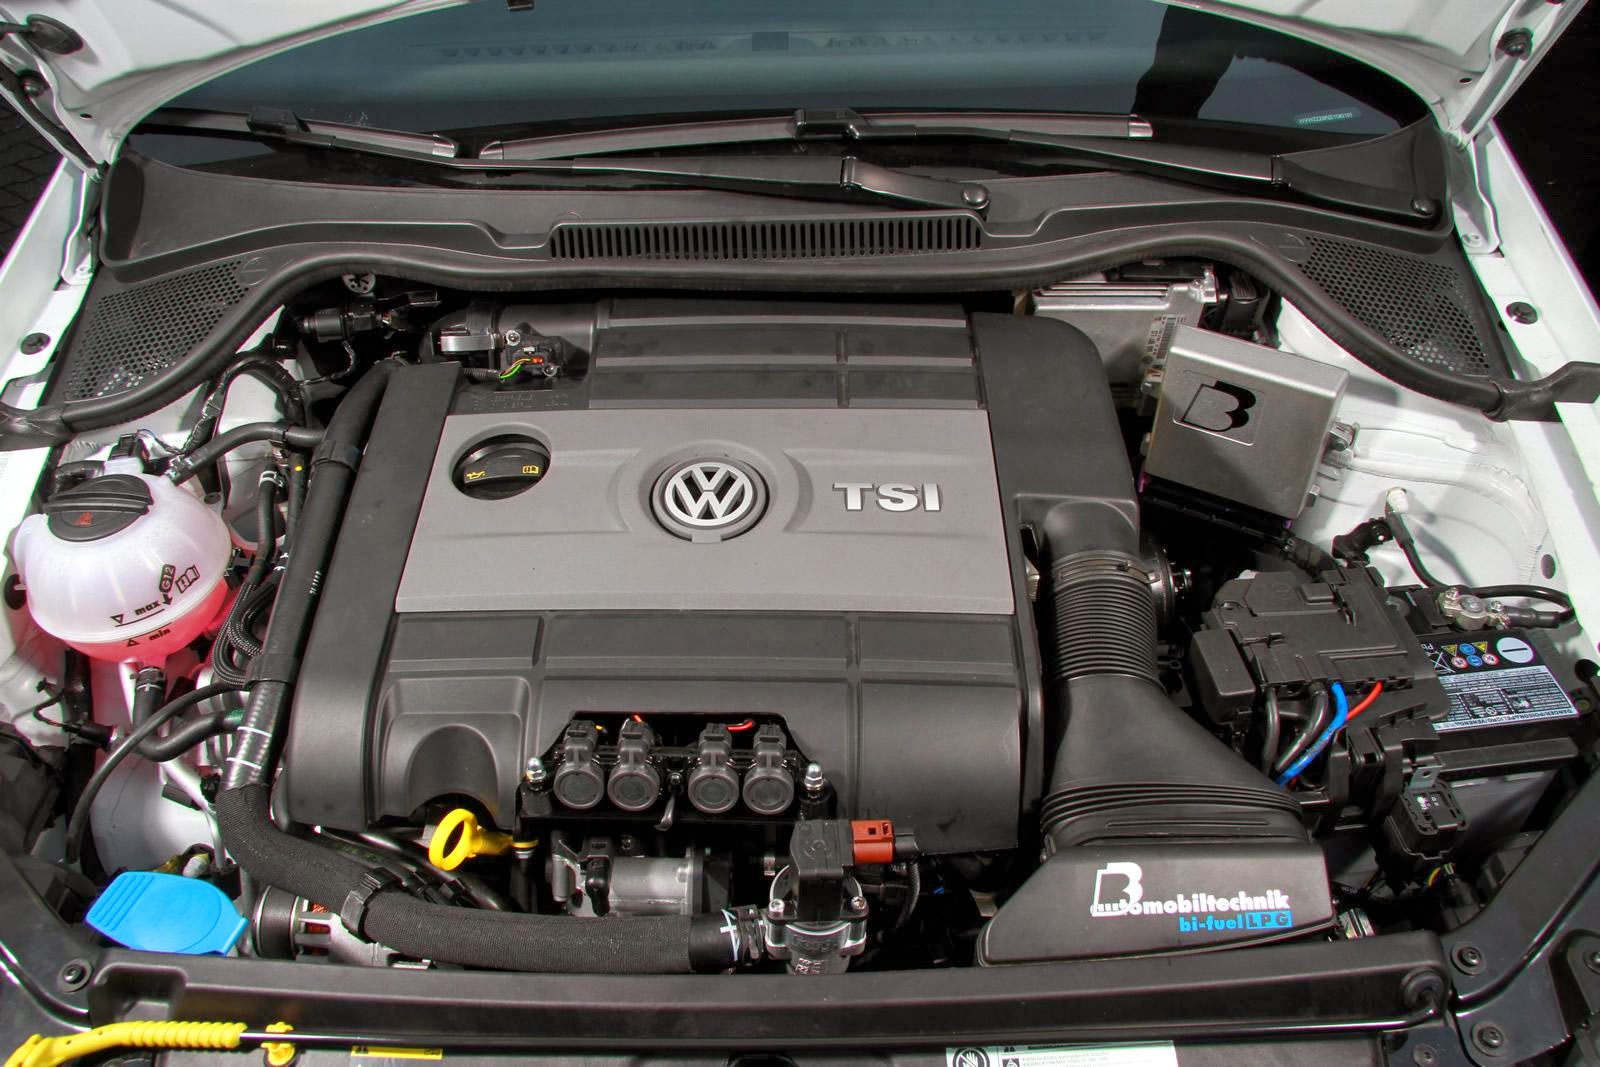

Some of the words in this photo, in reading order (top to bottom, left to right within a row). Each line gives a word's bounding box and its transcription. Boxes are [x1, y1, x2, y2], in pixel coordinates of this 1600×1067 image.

[833, 482, 941, 512] TSI
[161, 565, 175, 591] G12
[135, 600, 161, 615] max
[149, 629, 171, 641] min
[1179, 914, 1243, 932] bi-fuel
[1247, 911, 1291, 929] LPG
